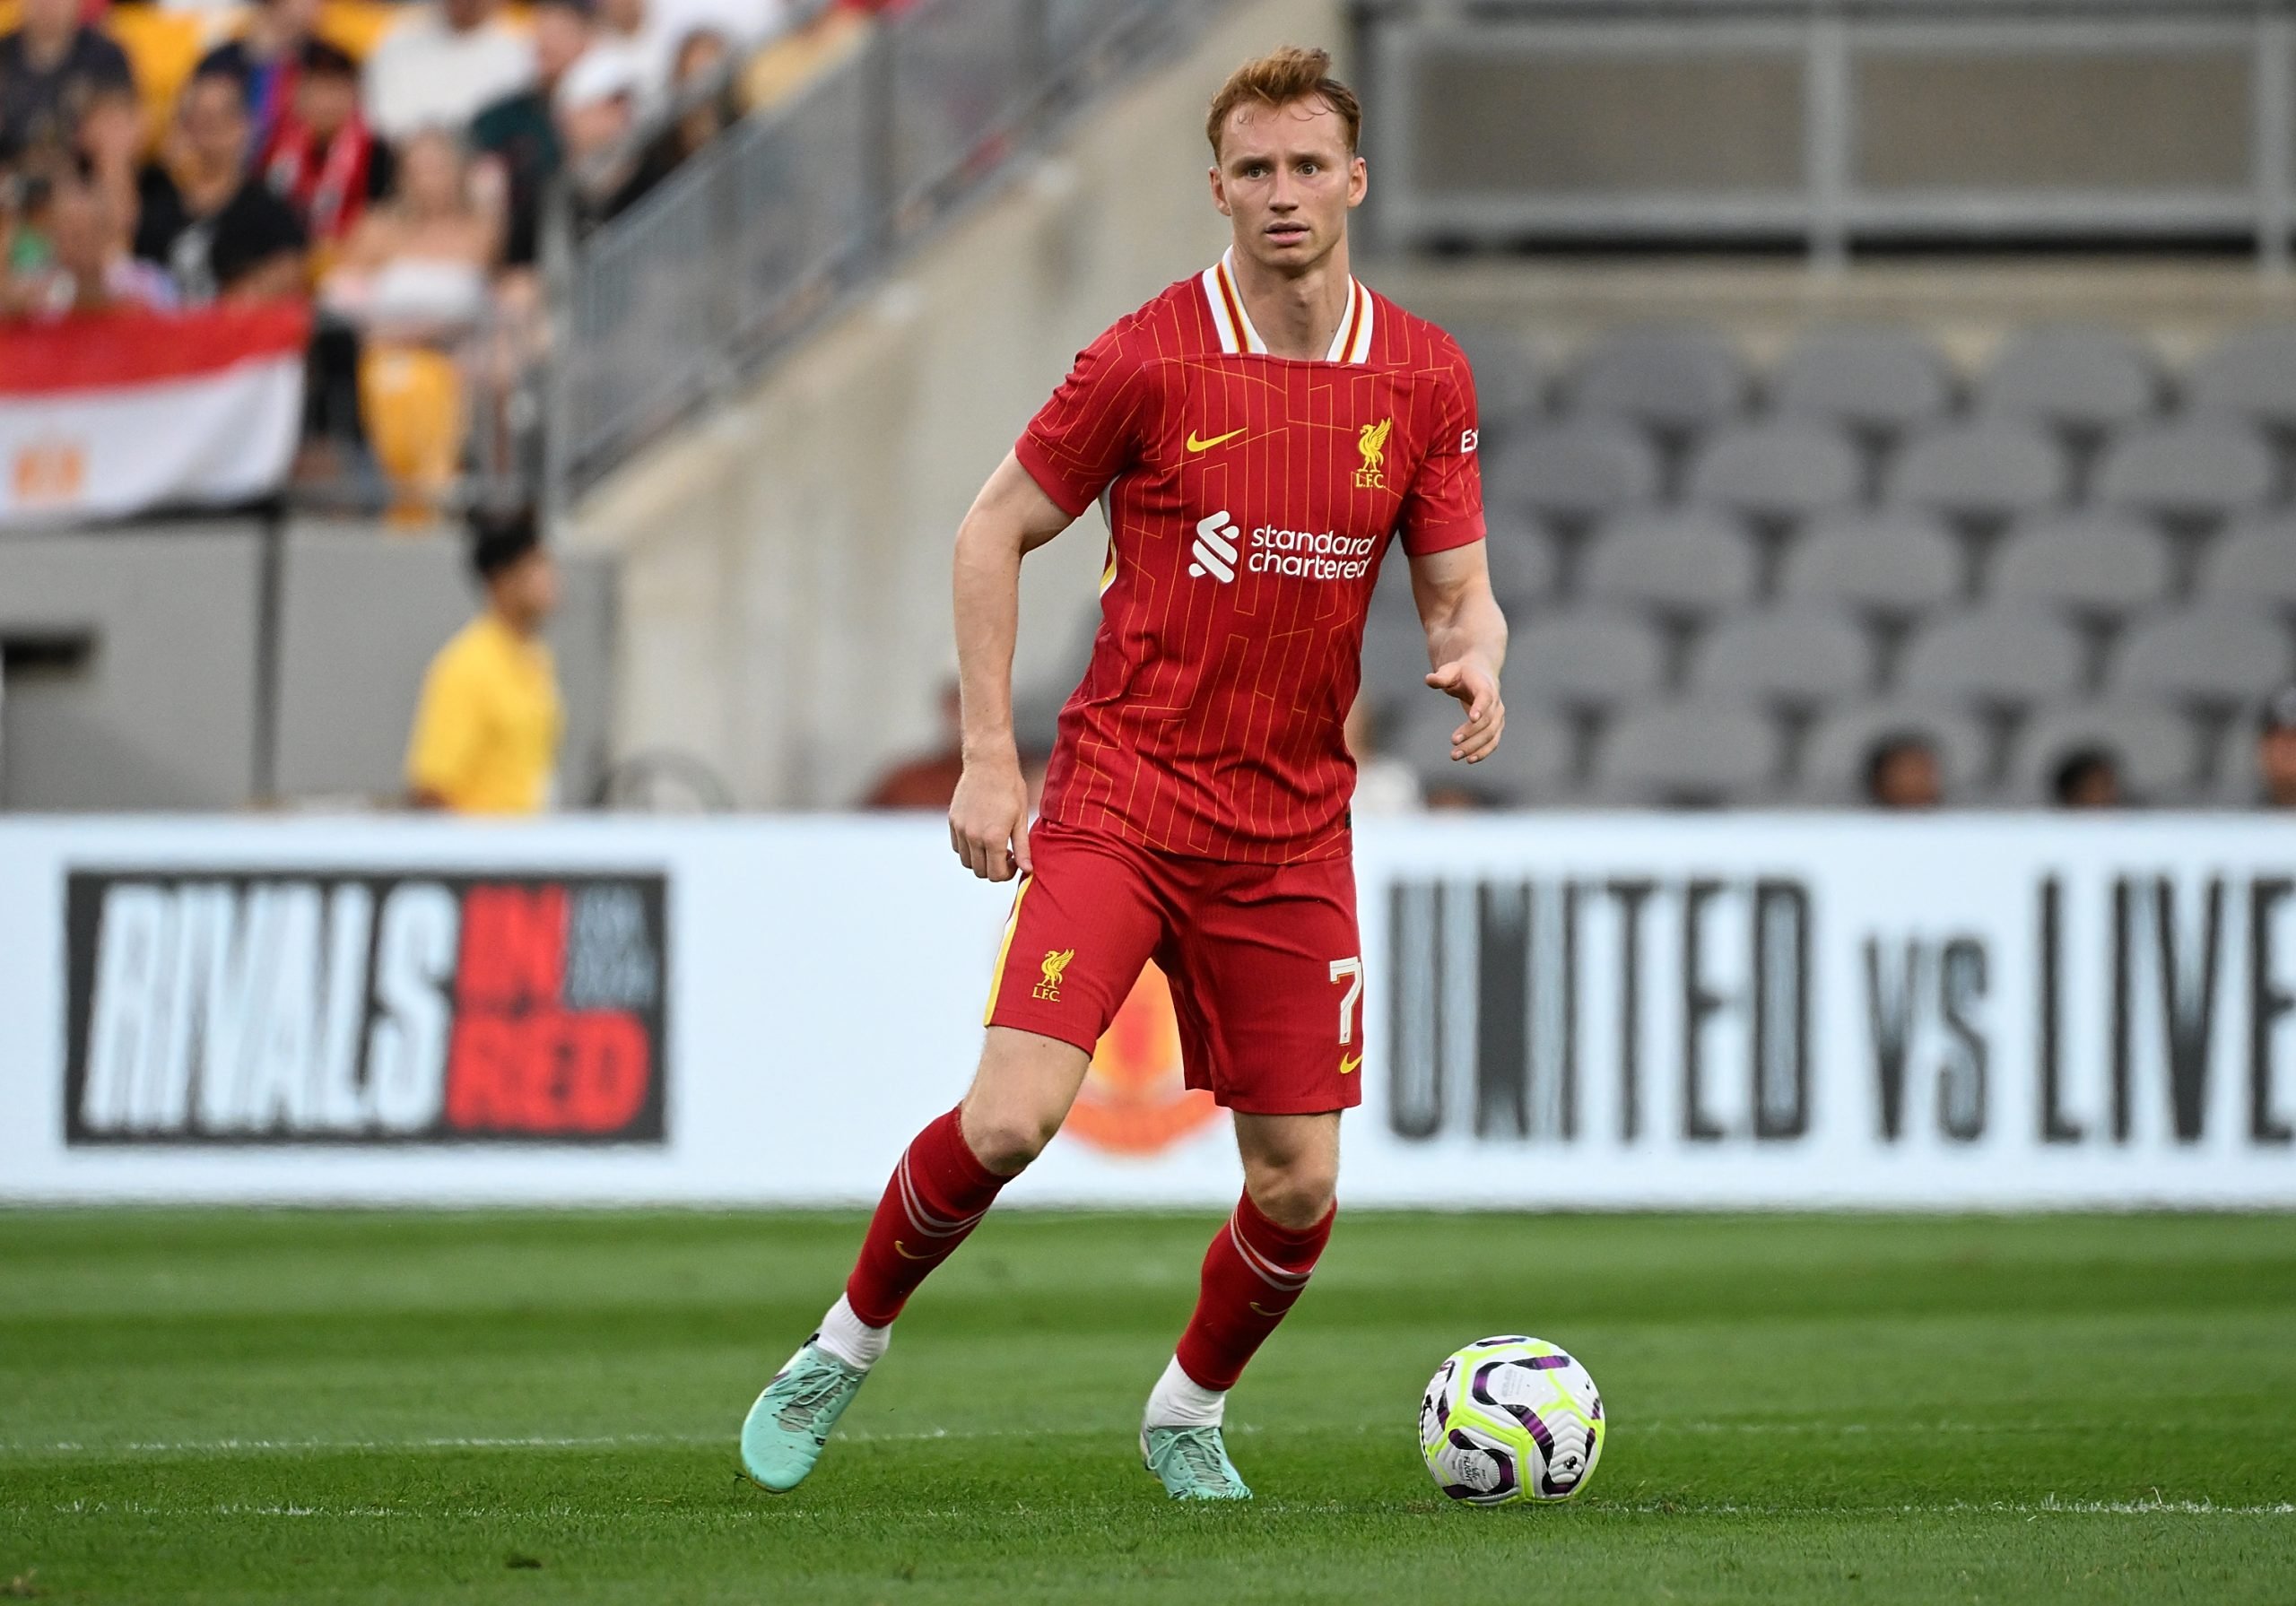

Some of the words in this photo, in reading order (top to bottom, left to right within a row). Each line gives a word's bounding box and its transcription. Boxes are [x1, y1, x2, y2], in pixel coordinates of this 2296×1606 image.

[1248, 549, 1372, 580] chartered
[1251, 524, 1377, 556] standard
[81, 879, 459, 1133] RIVALS
[1329, 956, 1364, 1046] 7
[1387, 873, 1813, 1144] UNITED
